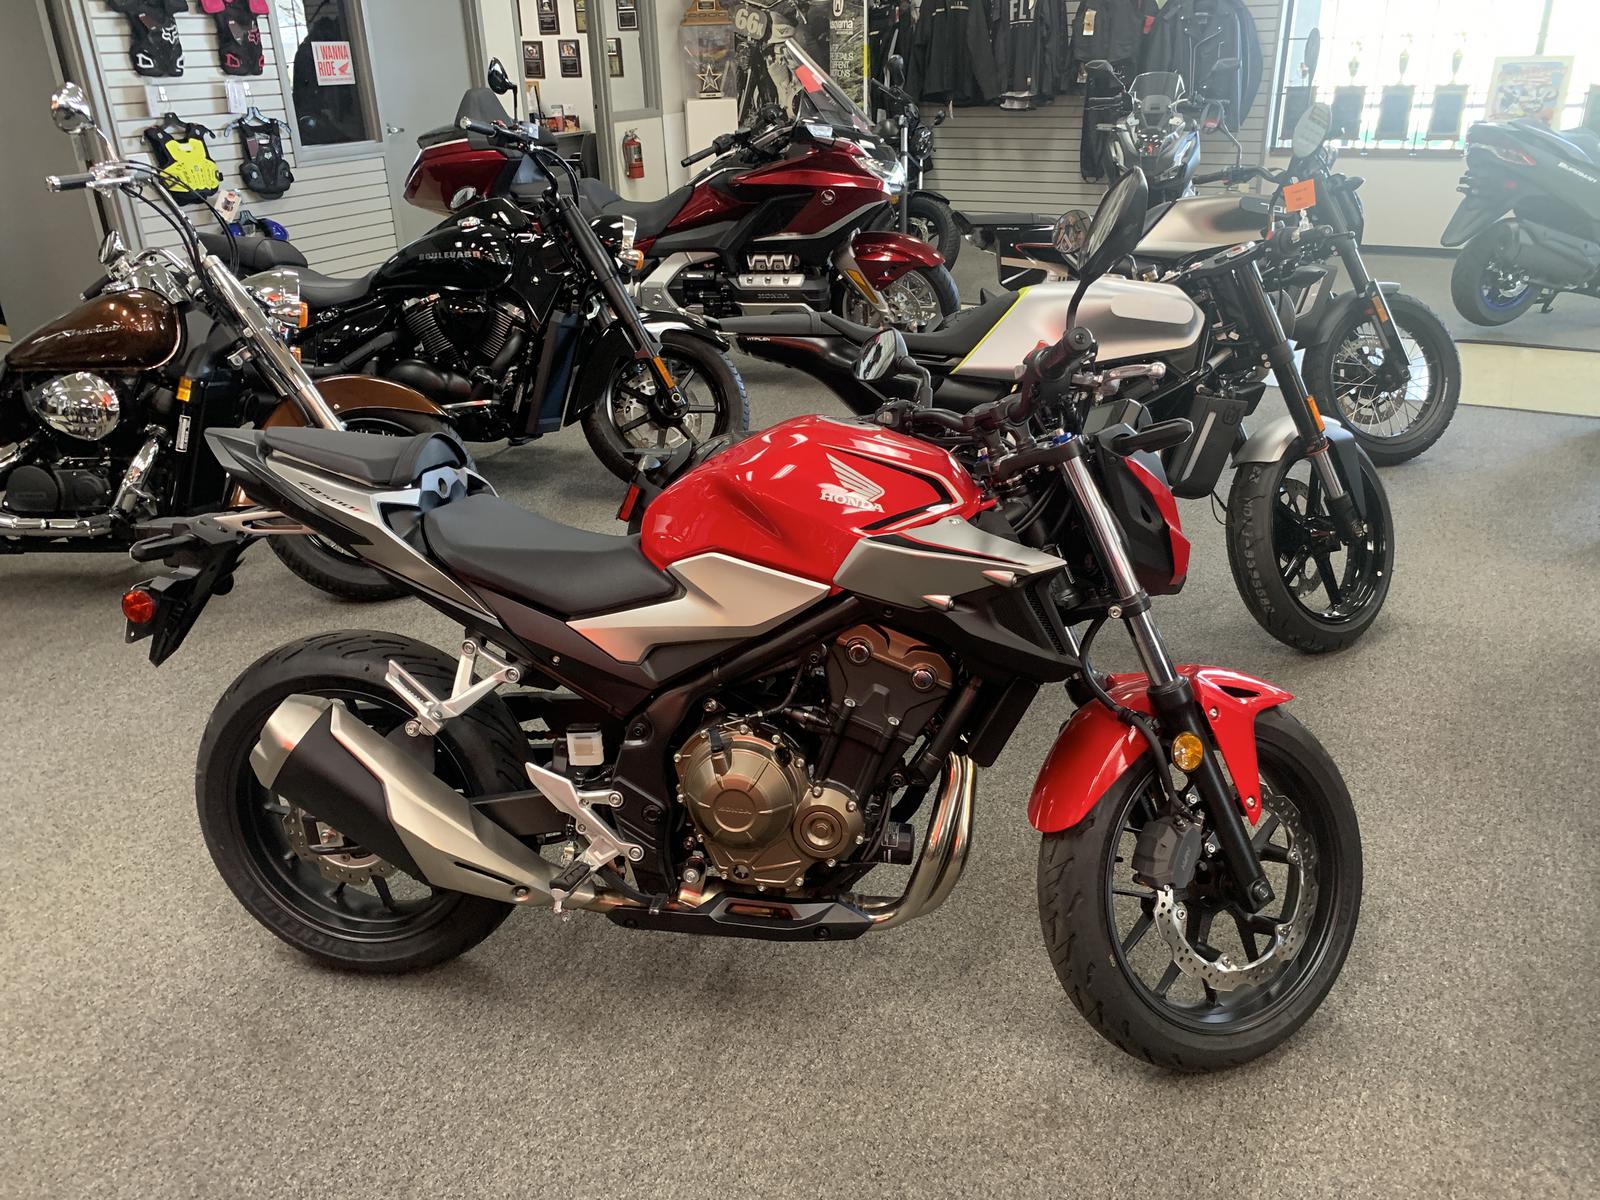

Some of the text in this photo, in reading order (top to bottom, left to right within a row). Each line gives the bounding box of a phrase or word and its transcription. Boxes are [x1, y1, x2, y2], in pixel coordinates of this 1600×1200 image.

[320, 45, 349, 60] WANNA
[318, 61, 336, 76] RIDE
[418, 250, 481, 261] BOULEVARD
[819, 487, 886, 514] HONDA
